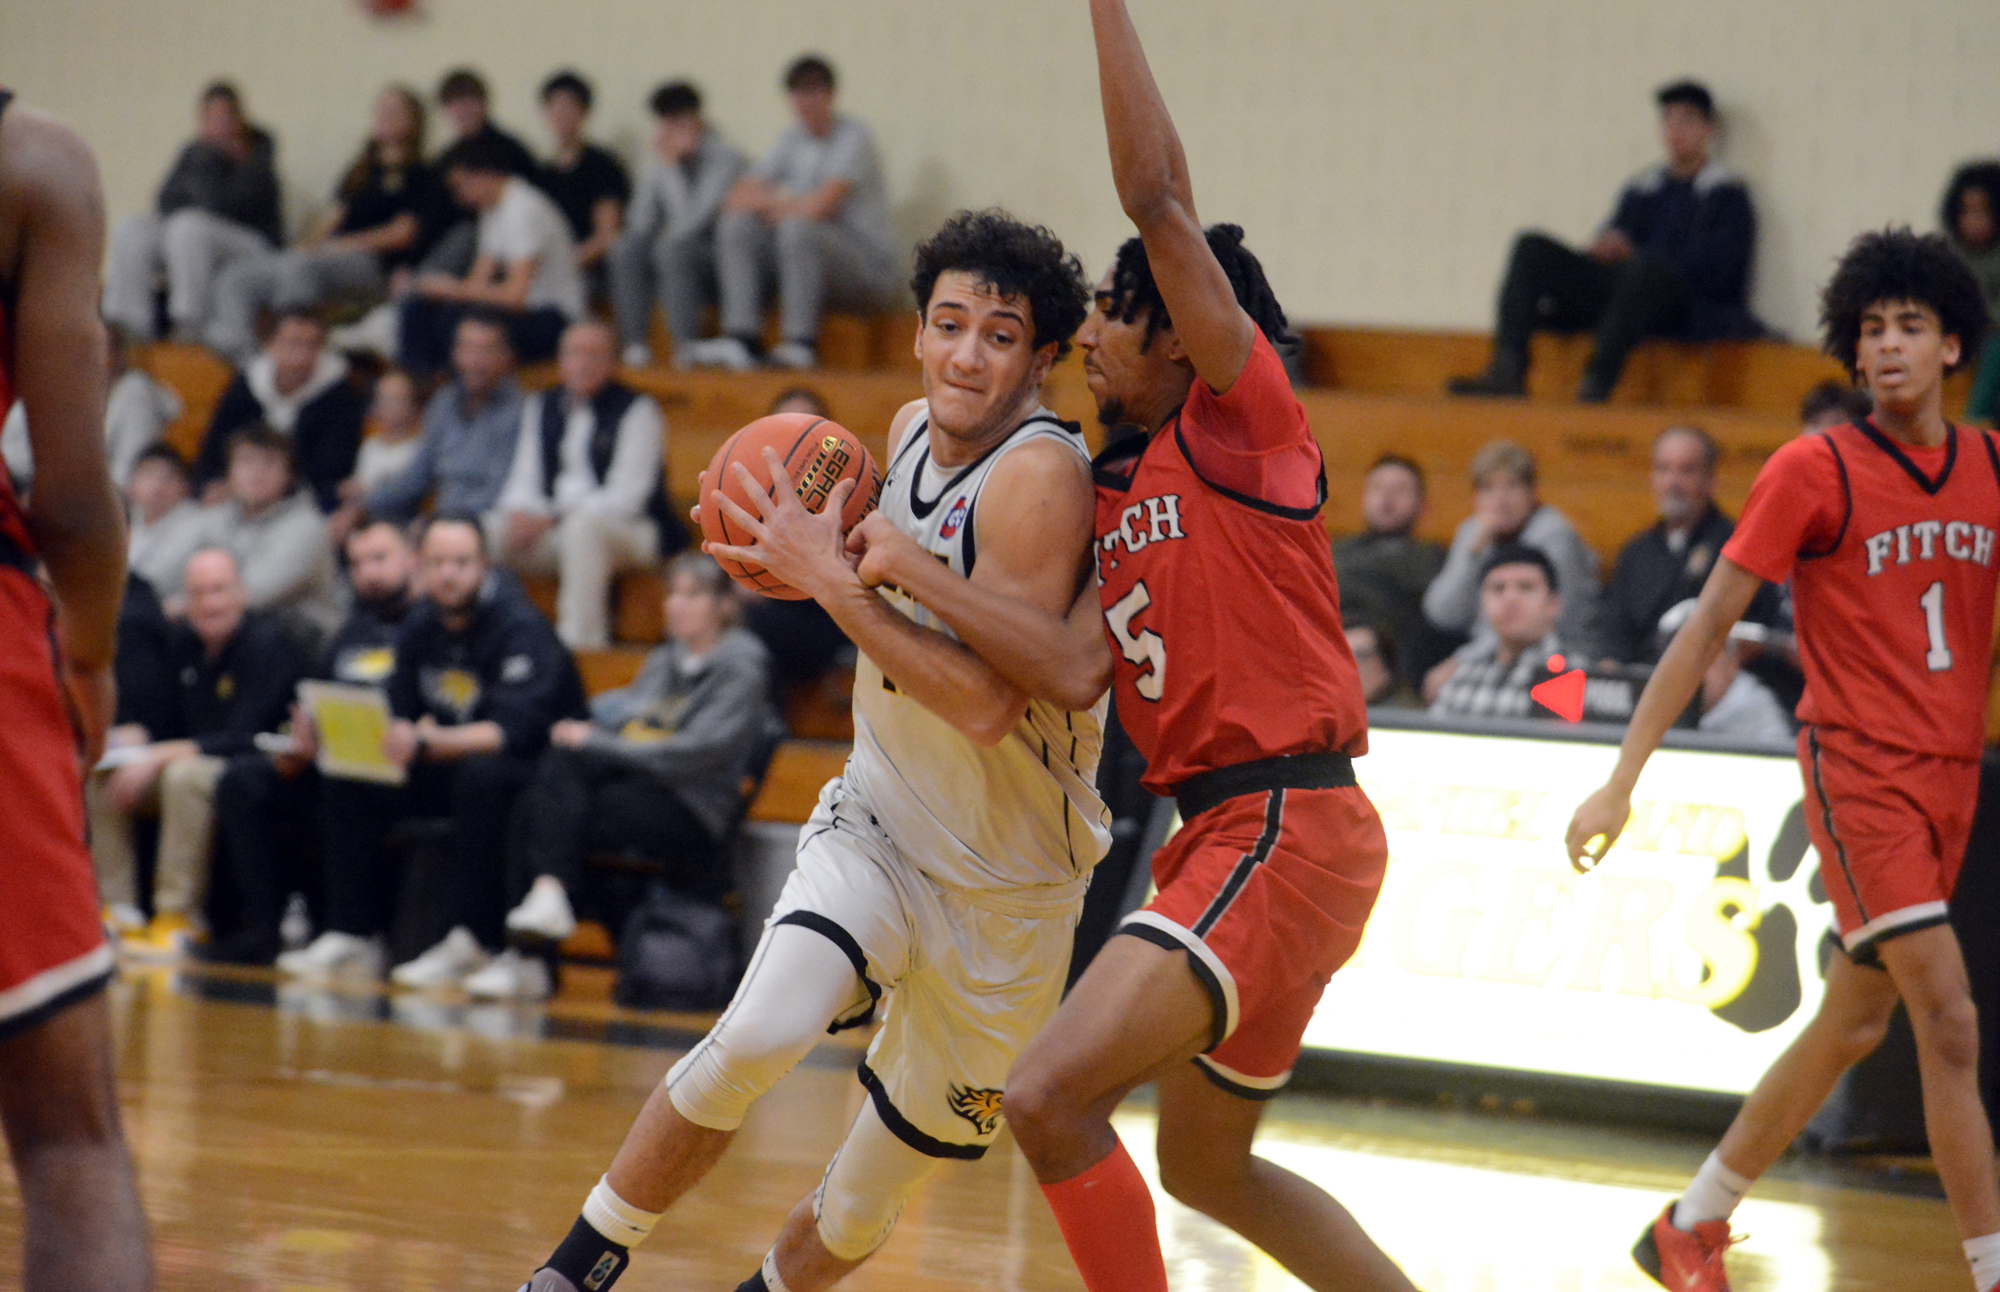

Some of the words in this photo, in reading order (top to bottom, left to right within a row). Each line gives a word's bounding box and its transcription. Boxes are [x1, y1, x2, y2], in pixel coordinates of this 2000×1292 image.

[1864, 519, 1996, 577] FITCH
[1103, 577, 1167, 703] 5
[1920, 580, 1953, 672] 1
[1352, 858, 1763, 1009] GERS
